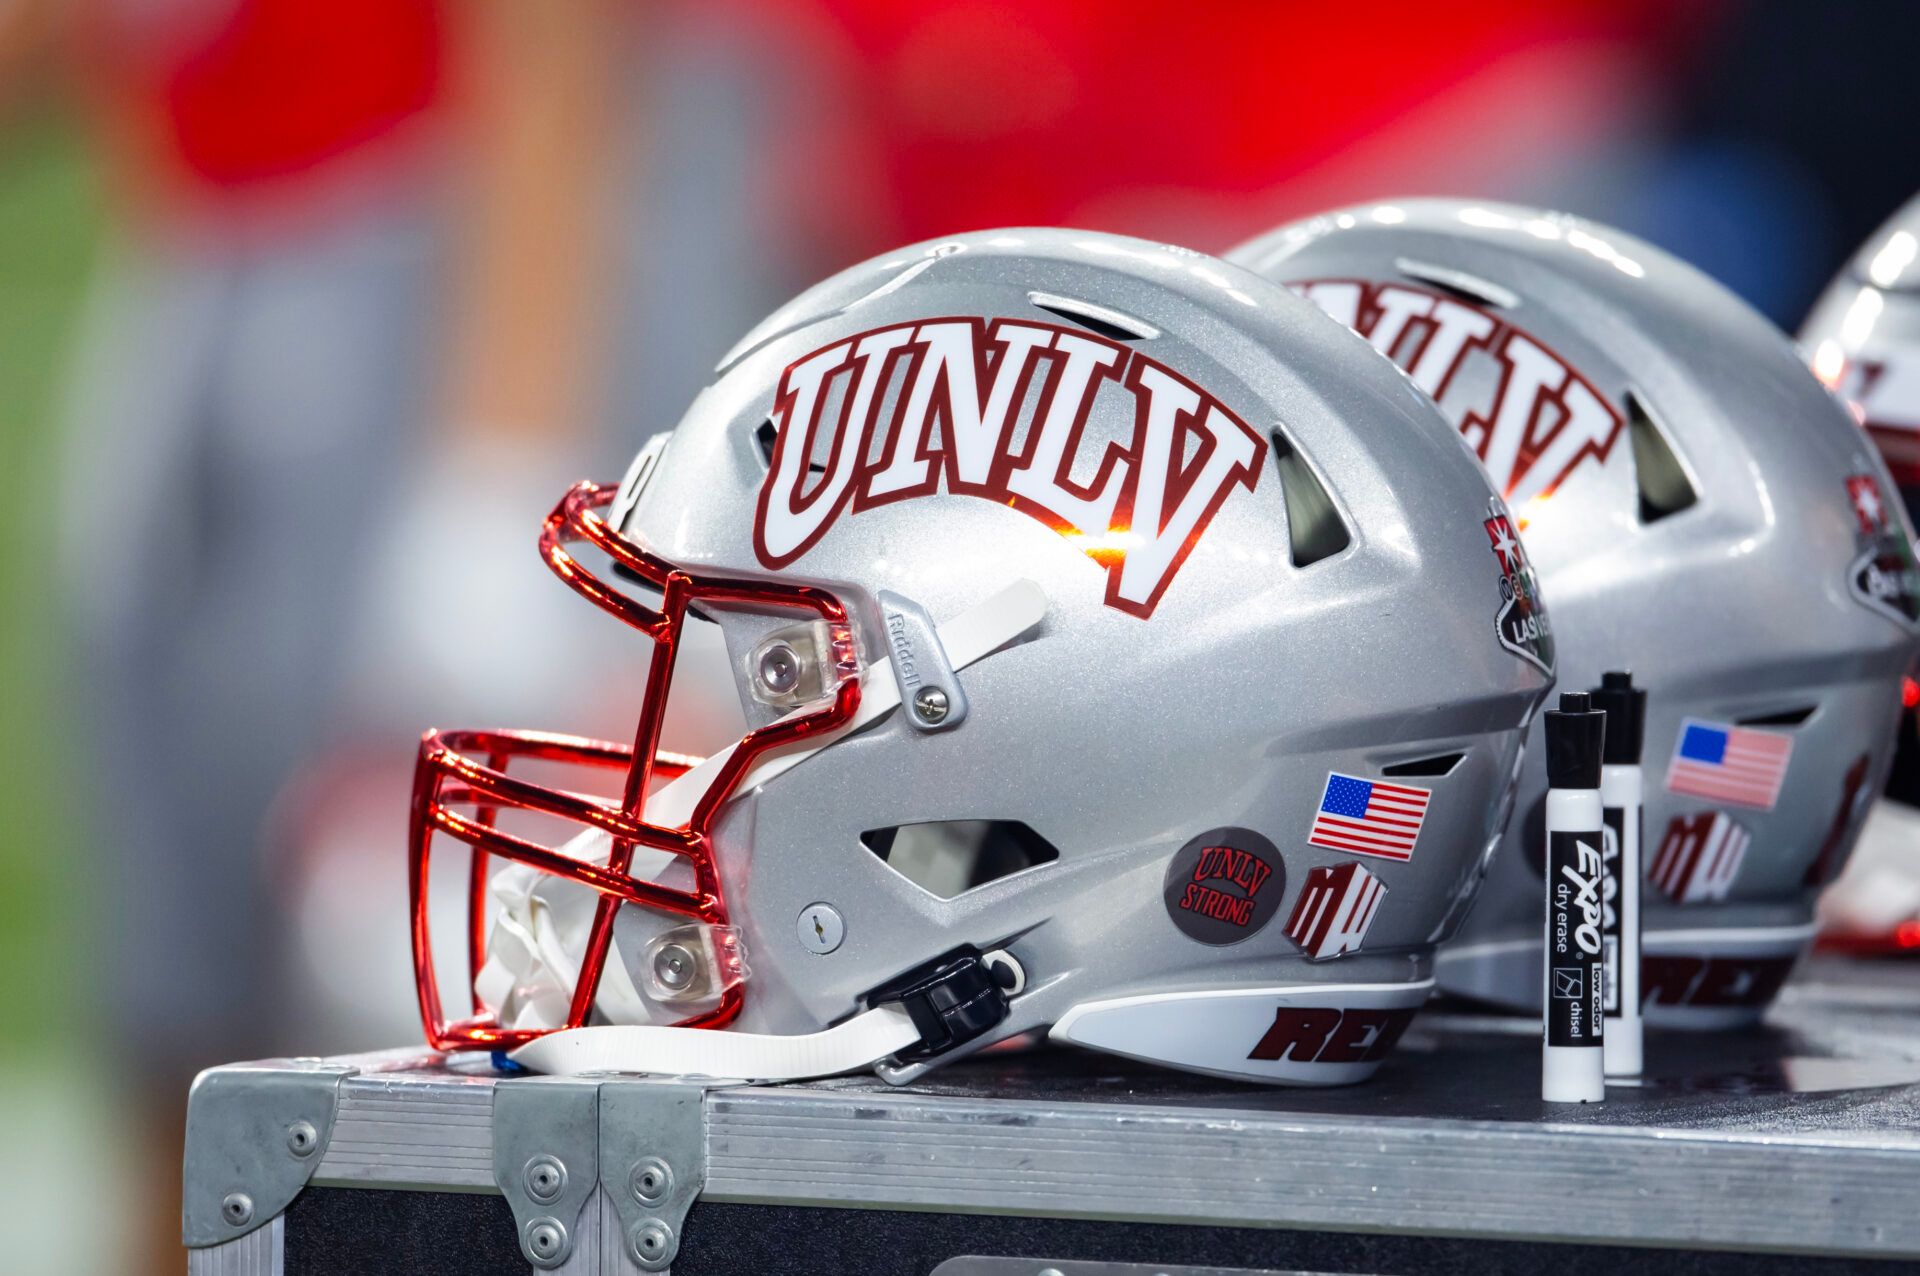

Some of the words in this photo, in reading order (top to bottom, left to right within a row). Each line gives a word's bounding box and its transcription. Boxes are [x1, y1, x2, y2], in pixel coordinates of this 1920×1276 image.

[1284, 279, 1626, 502] NLV
[753, 316, 1268, 621] UNLV
[887, 613, 922, 686] Riddell
[1193, 846, 1272, 899] UNLV
[1180, 883, 1256, 927] STRONG
[1554, 883, 1572, 911] dry
[1556, 912, 1568, 953] erase
[1593, 967, 1602, 993] low
[1570, 1001, 1583, 1038] chisel
[1593, 996, 1602, 1030] odor
